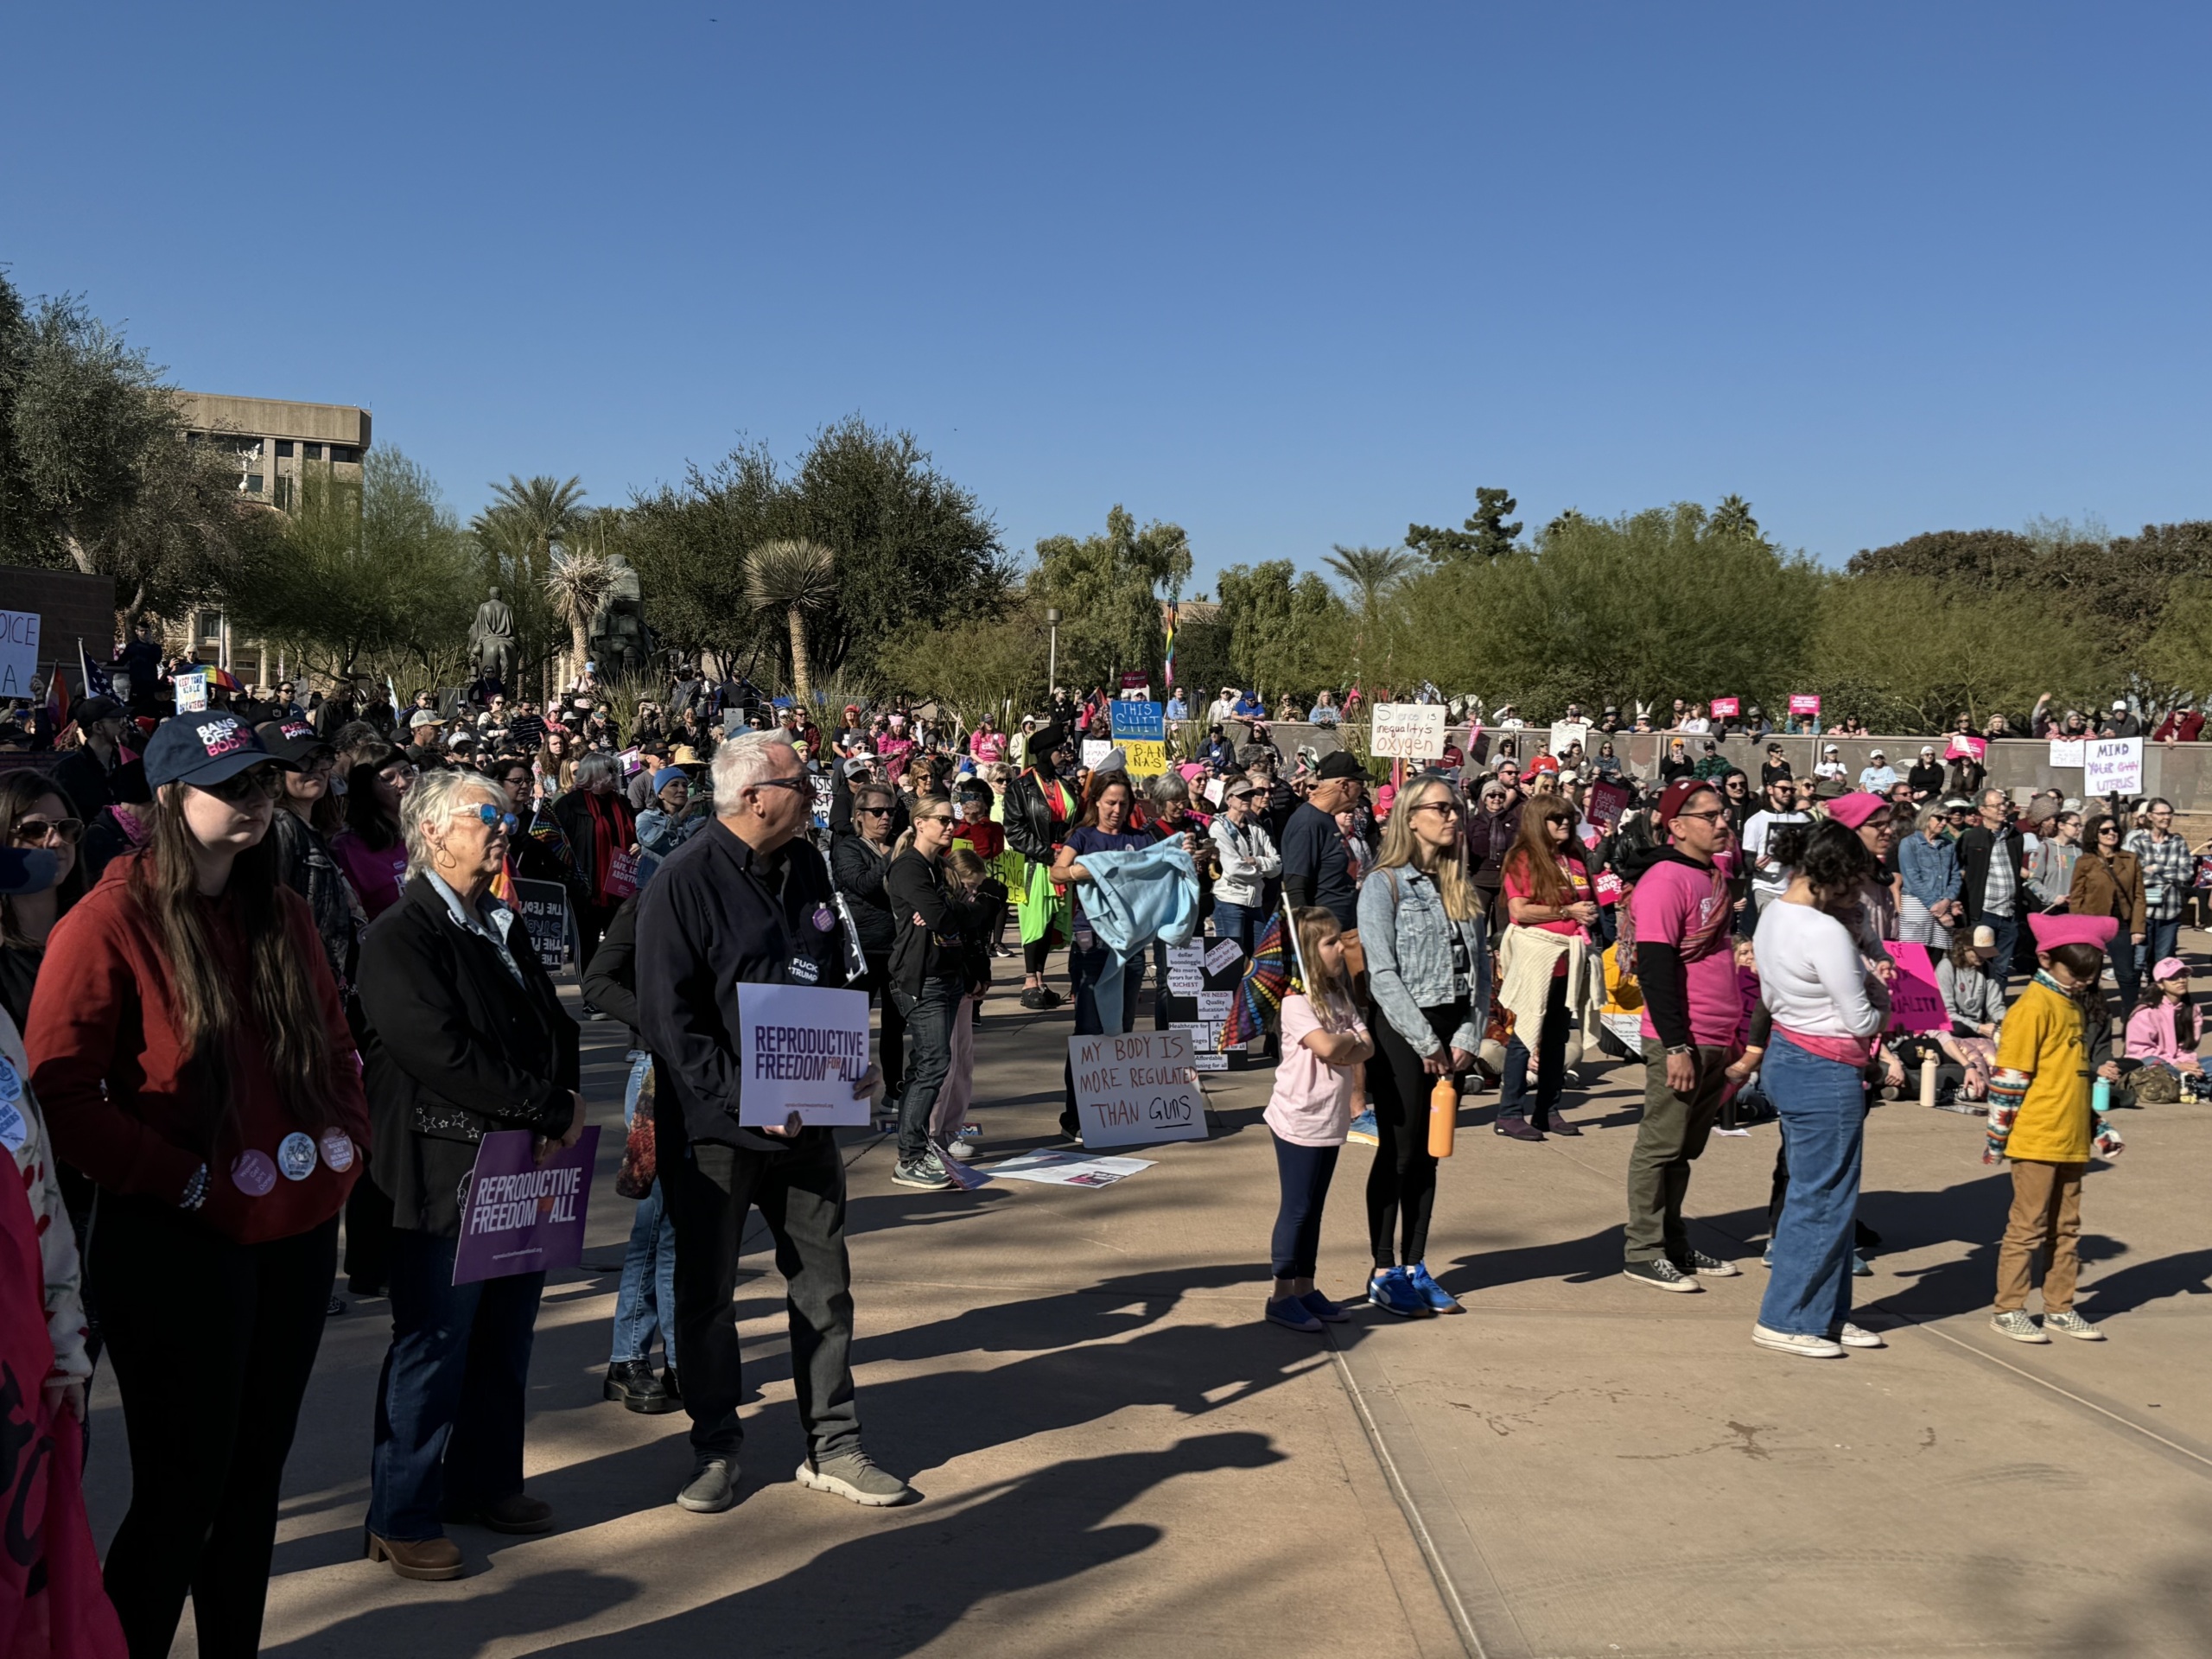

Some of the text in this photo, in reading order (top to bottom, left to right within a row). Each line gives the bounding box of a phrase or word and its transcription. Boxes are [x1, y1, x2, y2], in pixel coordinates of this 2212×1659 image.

[1120, 702, 1153, 716] THIS
[196, 717, 238, 739] BANS
[1116, 713, 1160, 733] SHIT
[202, 728, 233, 746] OFF
[207, 734, 248, 757] BODY
[2097, 743, 2129, 758] MIND
[2088, 761, 2114, 775] YOUR
[2097, 776, 2135, 792] UTERUS
[546, 902, 563, 916] THE
[1215, 939, 1230, 952] MORE
[791, 966, 818, 982] TRUMP
[792, 957, 818, 973] FUCK
[1891, 996, 1937, 1014] UALITY
[755, 1026, 864, 1057] REPRODUCTIVE
[1081, 1041, 1103, 1065] MY
[1115, 1036, 1151, 1061] BODY
[1159, 1036, 1184, 1058] IS
[755, 1052, 861, 1082] FREEDOM FOR ALL
[1080, 1065, 1198, 1094] MORE REGULATED
[1090, 1099, 1140, 1128] THAN
[476, 1167, 582, 1206] REPRODUCTIVE
[470, 1198, 538, 1236] FREEDOM
[549, 1195, 576, 1224] ALL
